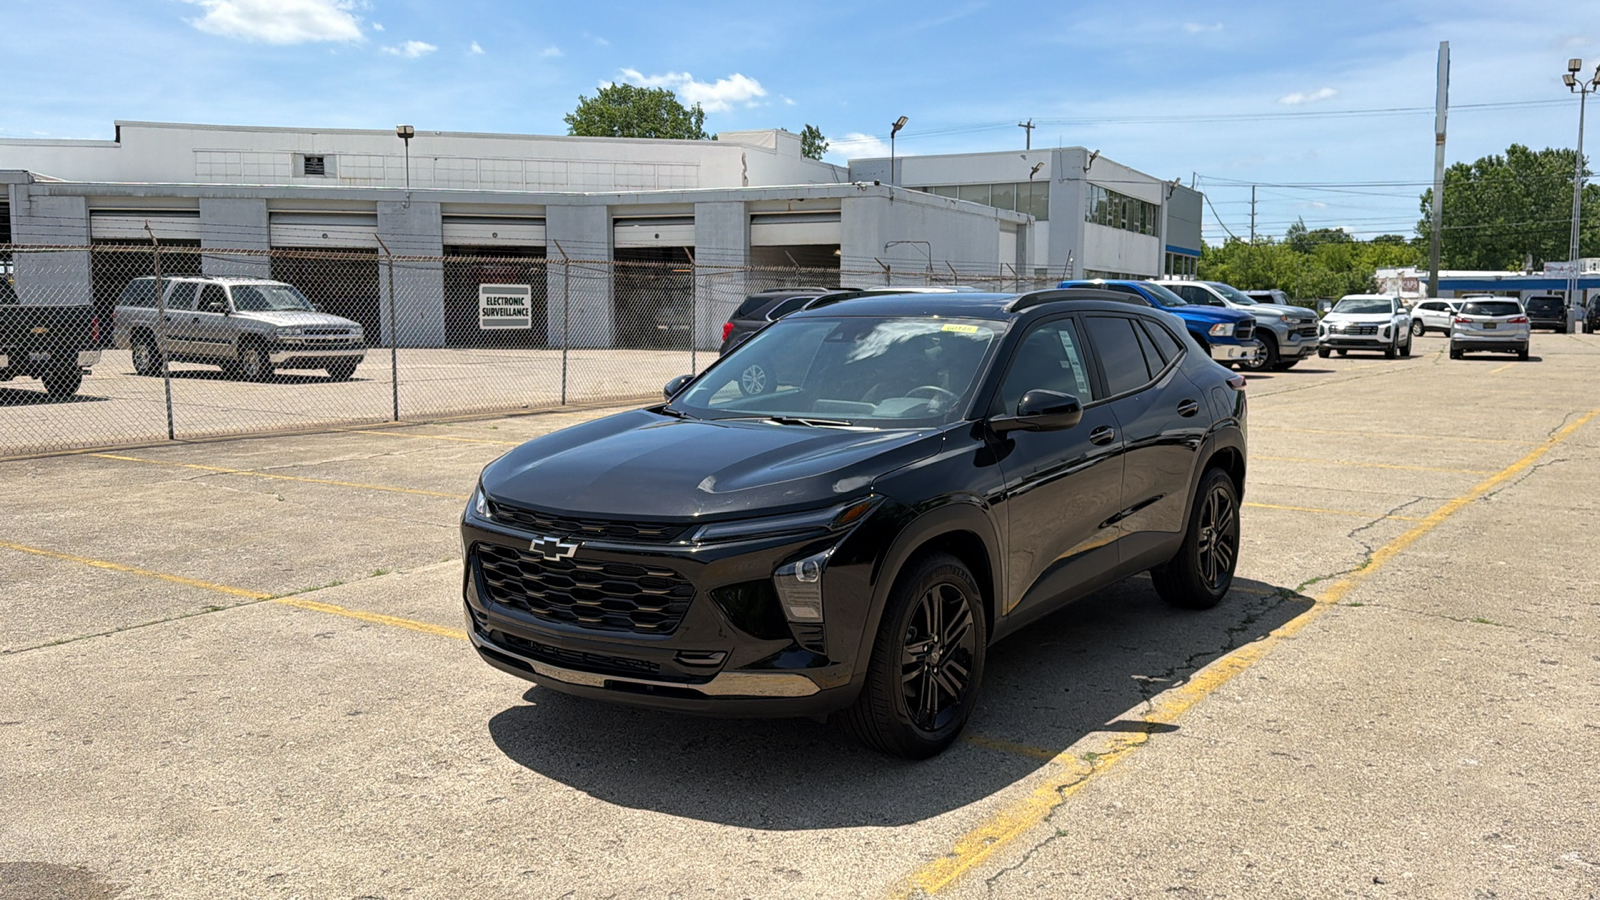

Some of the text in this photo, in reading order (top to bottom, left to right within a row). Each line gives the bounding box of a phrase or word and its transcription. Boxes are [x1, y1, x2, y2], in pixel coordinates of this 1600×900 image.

[1403, 280, 1418, 288] CAPS
[486, 297, 525, 306] ELECTRONIC
[482, 307, 529, 317] SURVEILLANCE
